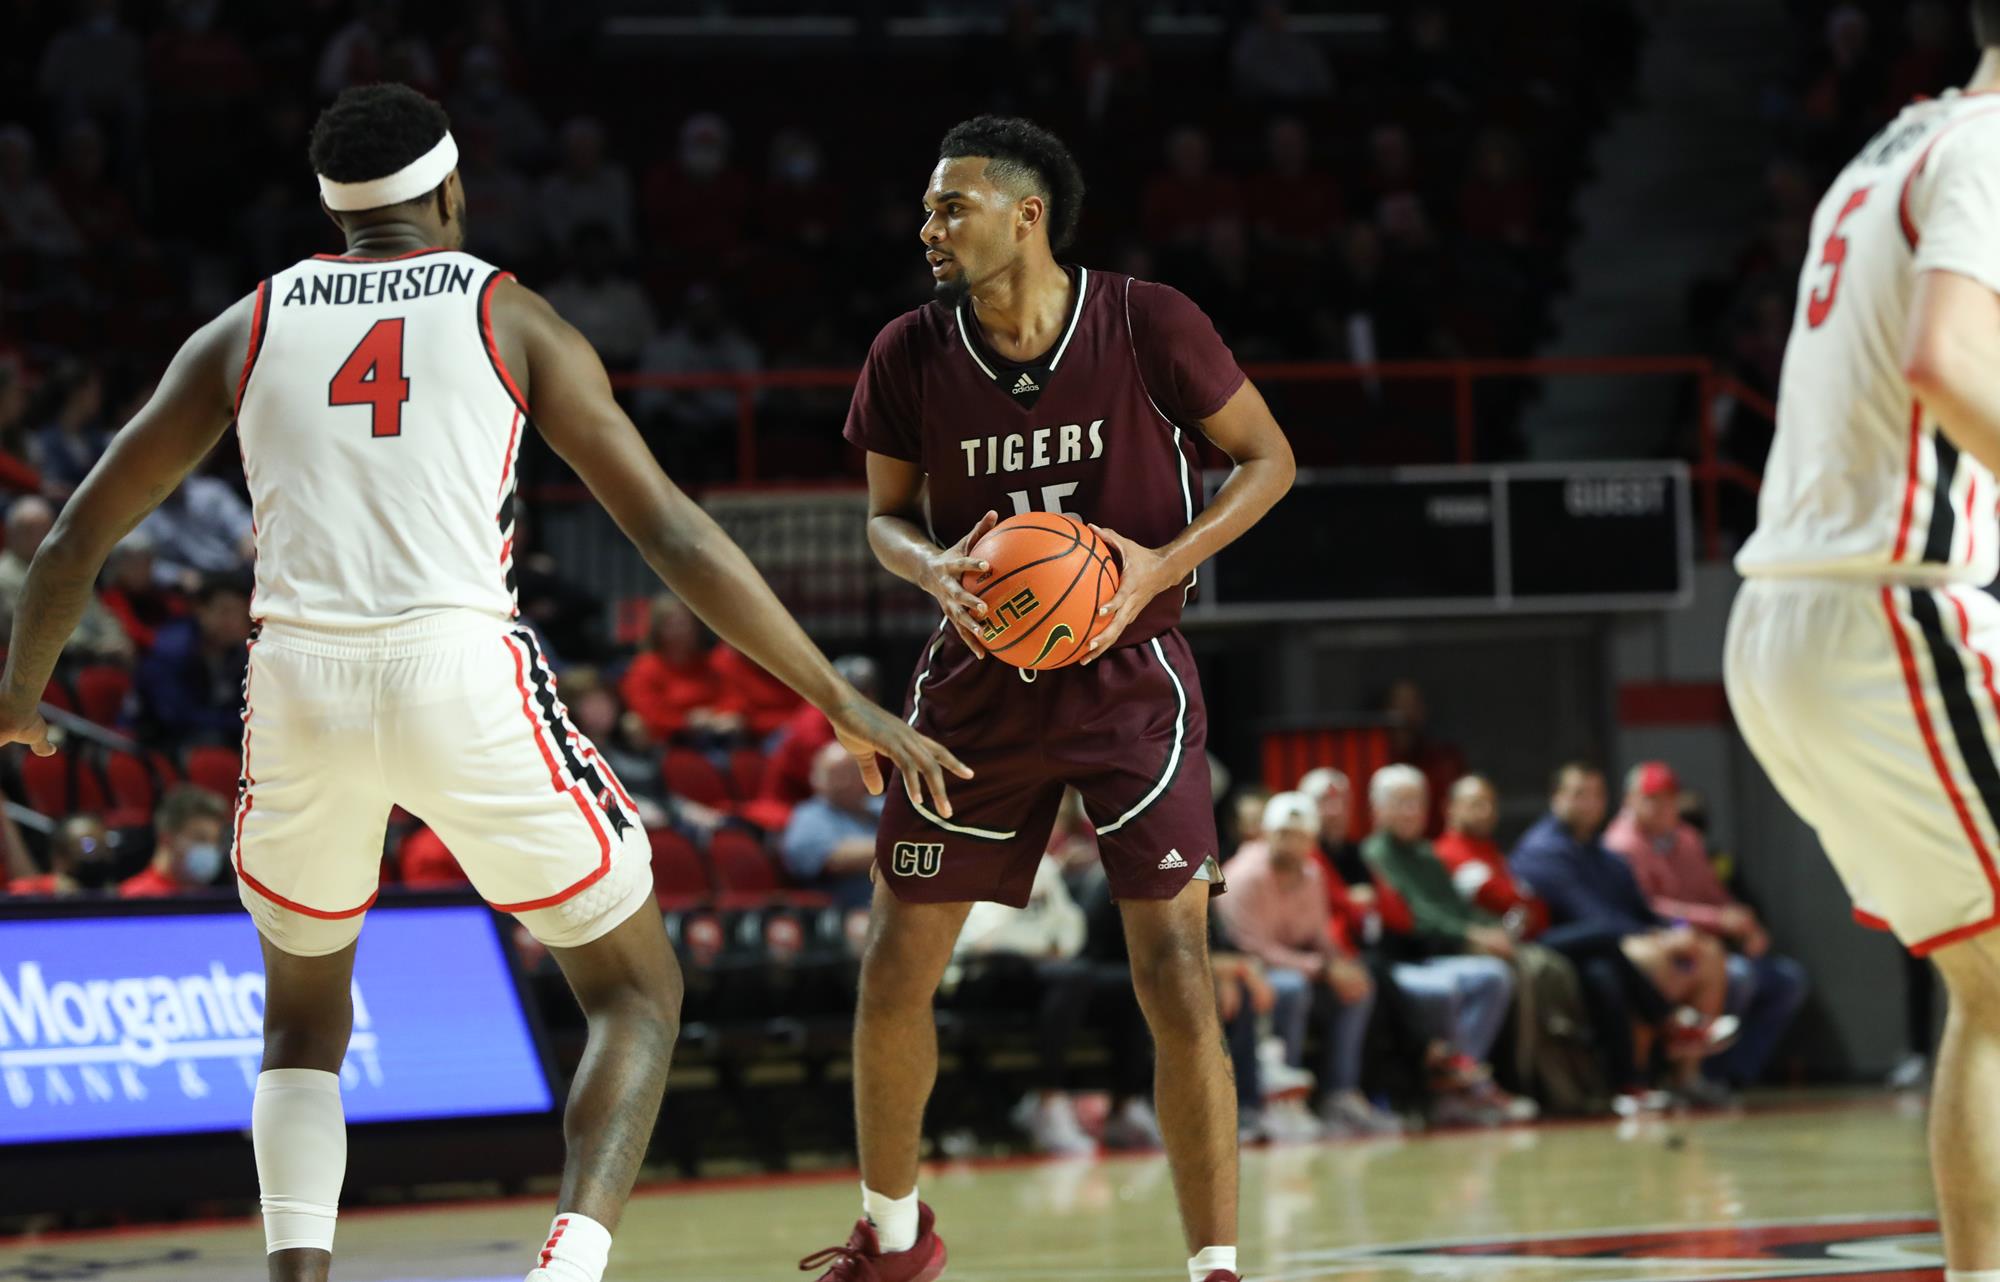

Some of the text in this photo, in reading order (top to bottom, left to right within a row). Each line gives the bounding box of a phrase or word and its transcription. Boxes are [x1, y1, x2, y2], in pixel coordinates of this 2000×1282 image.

[1807, 186, 1871, 328] 5
[283, 263, 474, 306] ANDERSON
[328, 317, 410, 438] 4
[1012, 383, 1040, 394] adidas
[960, 419, 1104, 477] TIGERS
[979, 587, 1041, 643] ELITE
[892, 842, 944, 878] CU
[1158, 859, 1188, 870] adidas
